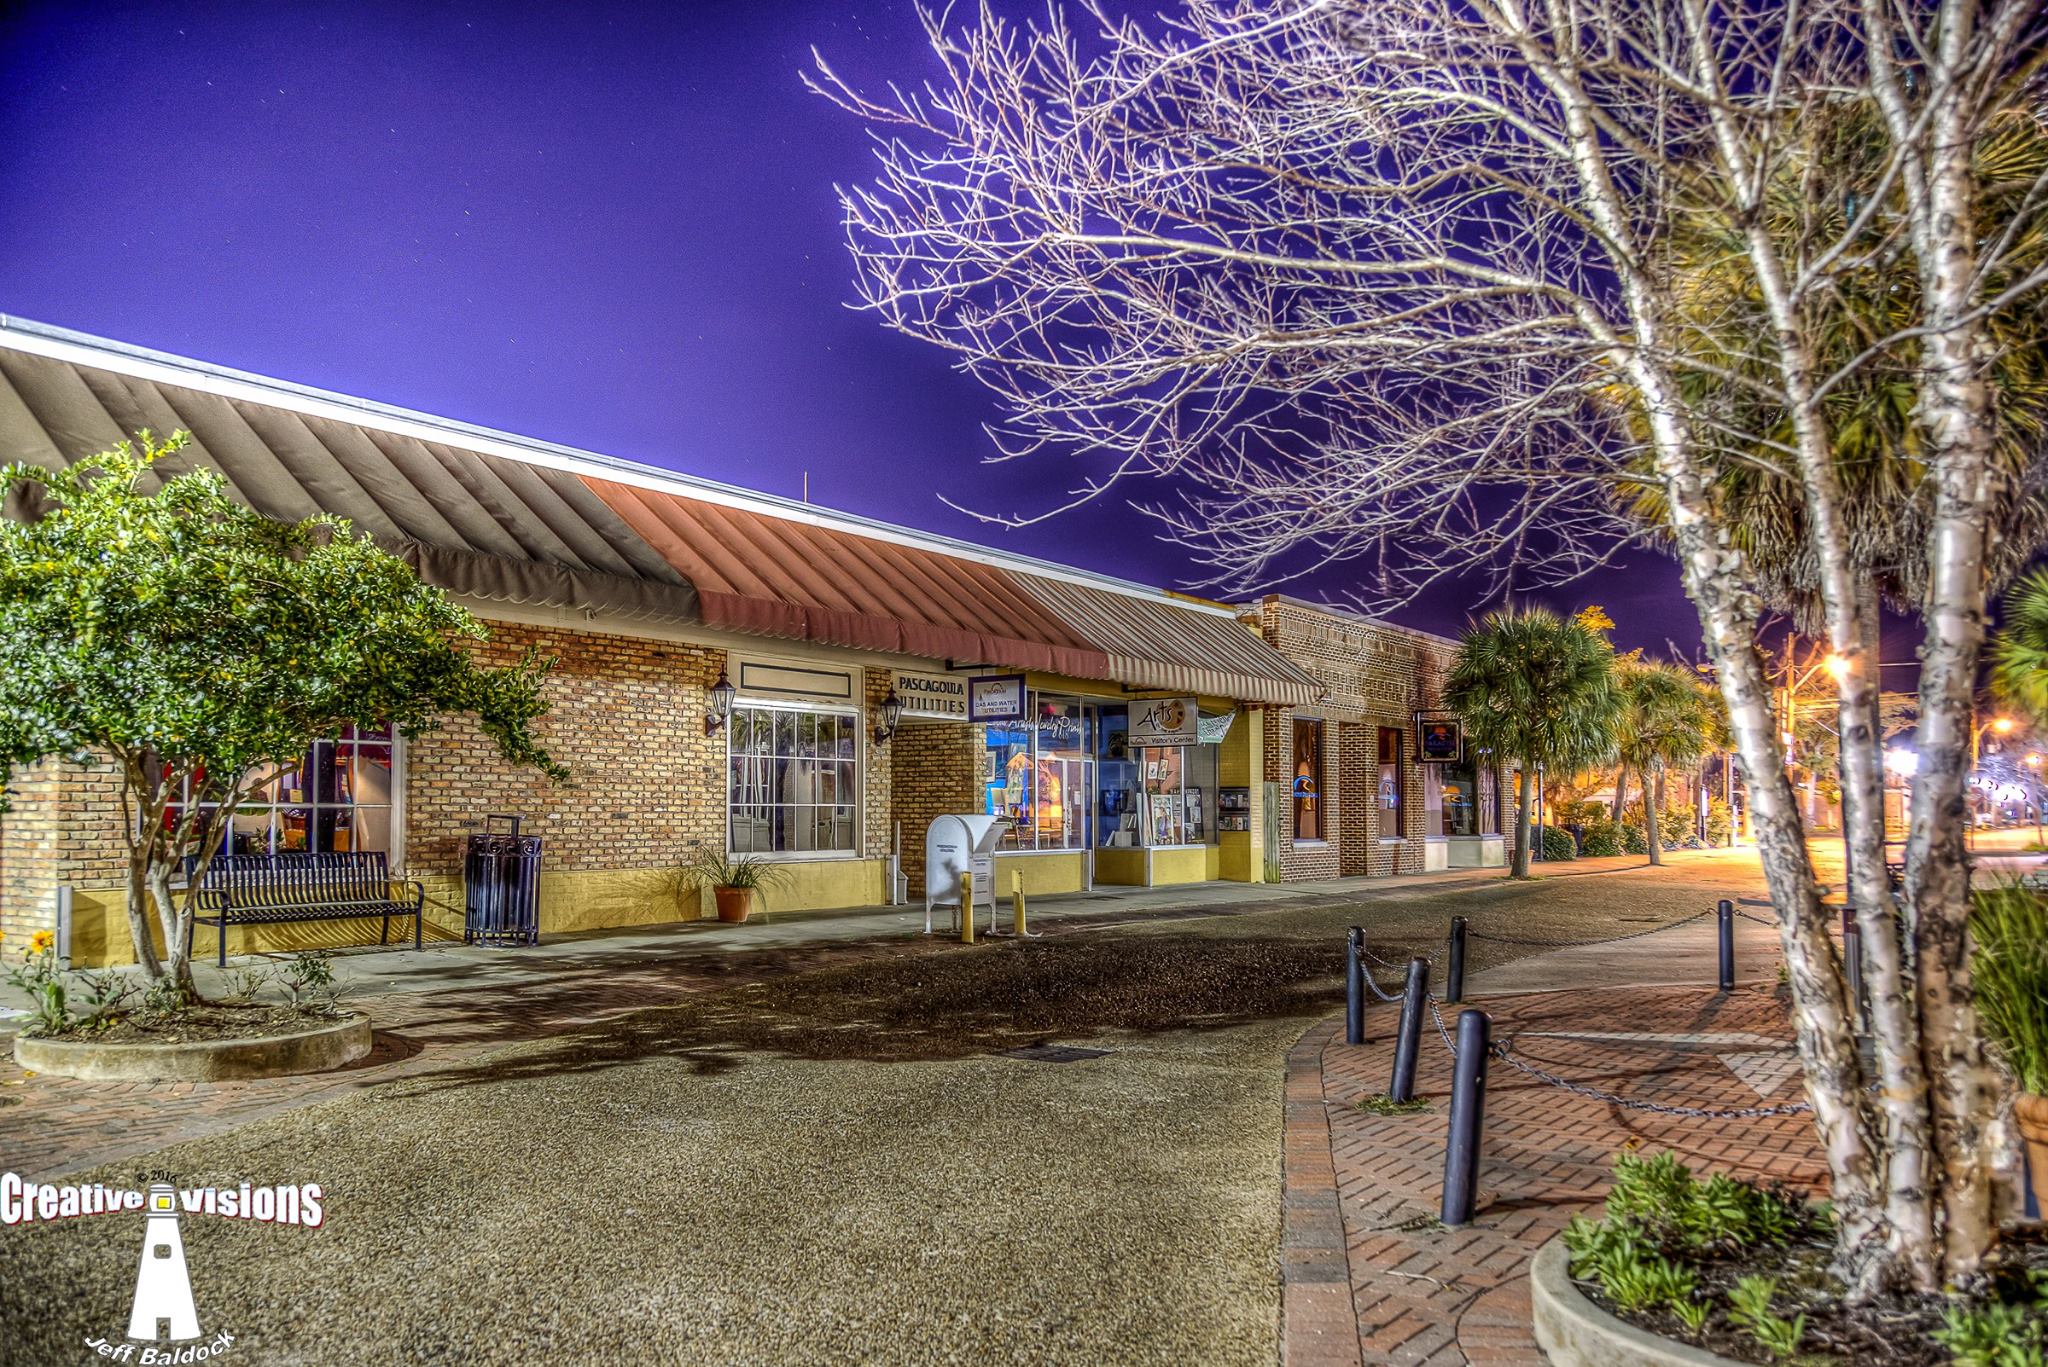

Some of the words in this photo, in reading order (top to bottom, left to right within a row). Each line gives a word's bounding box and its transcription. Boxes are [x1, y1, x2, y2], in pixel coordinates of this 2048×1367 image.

[899, 676, 964, 695] PASCAGOULA
[900, 695, 966, 713] UTILITIES
[1137, 701, 1173, 731] Arts
